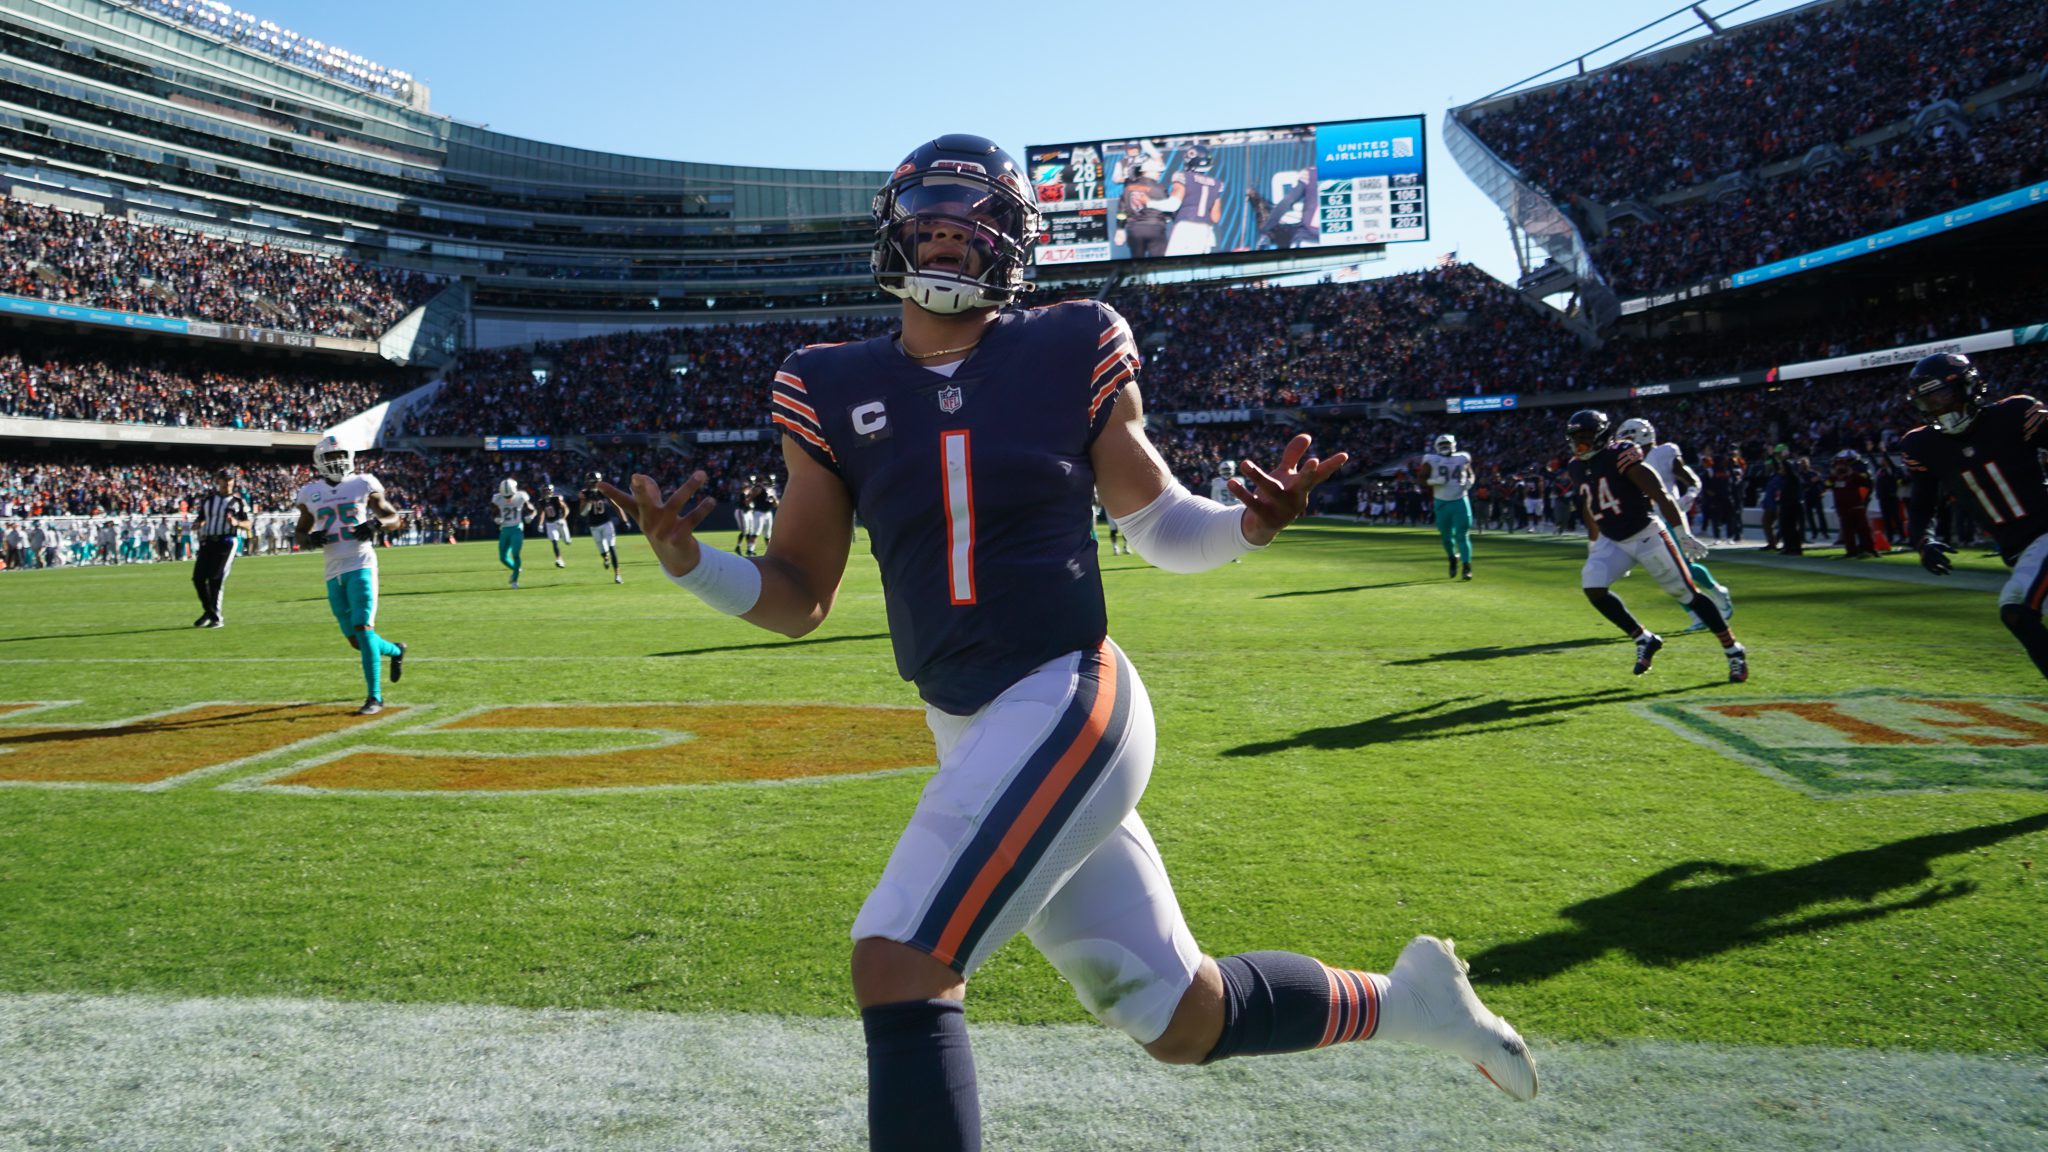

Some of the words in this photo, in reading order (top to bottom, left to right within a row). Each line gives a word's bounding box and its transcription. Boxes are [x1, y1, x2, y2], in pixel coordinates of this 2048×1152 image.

[1337, 140, 1389, 152] UNITED
[1325, 149, 1389, 161] AIRLINES
[1072, 164, 1096, 183] 28
[1075, 183, 1097, 200] 17
[1395, 190, 1417, 200] 106
[1328, 195, 1344, 205] 62
[1395, 217, 1418, 228] 202
[1039, 249, 1075, 262] ALTA
[1870, 354, 1892, 366] Game
[1893, 347, 1927, 362] Rushing
[851, 401, 887, 436] C
[1177, 409, 1250, 424] DOWN
[697, 431, 760, 443] BEAR
[1438, 464, 1462, 484] 94
[1580, 476, 1623, 522] 24
[1961, 461, 2027, 524] 11
[502, 507, 519, 520] 21
[940, 429, 977, 606] 1
[316, 500, 360, 545] 25
